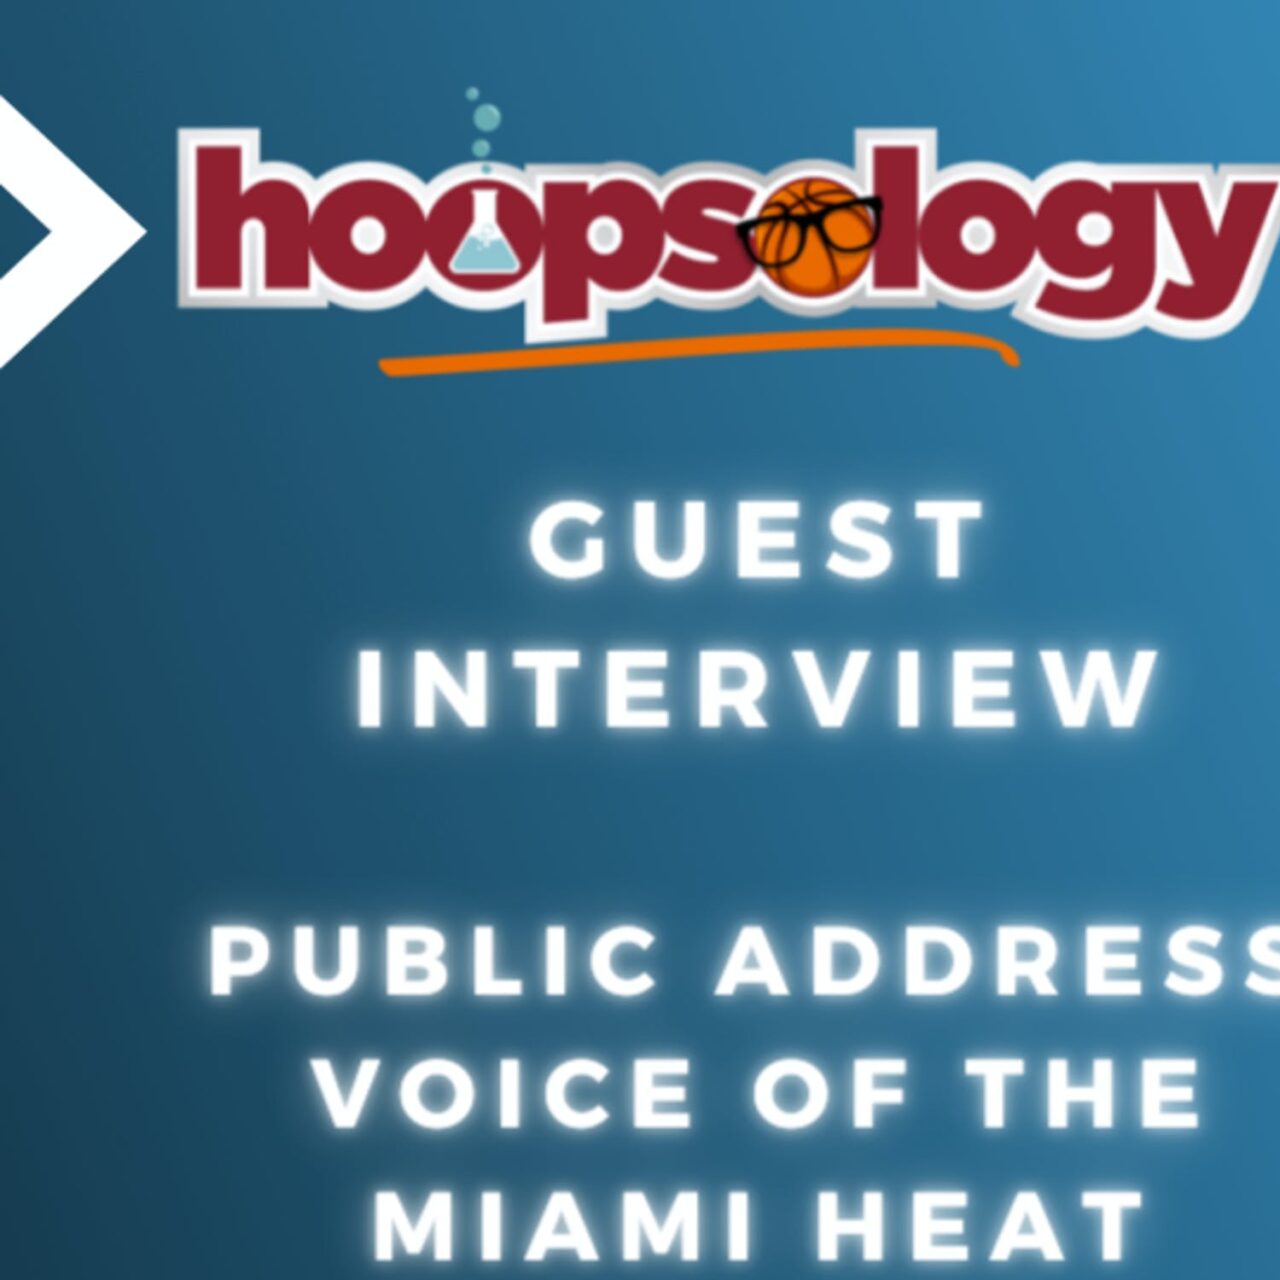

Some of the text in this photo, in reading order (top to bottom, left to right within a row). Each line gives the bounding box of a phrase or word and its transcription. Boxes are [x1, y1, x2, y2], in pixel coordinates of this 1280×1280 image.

[529, 499, 982, 580] GUEST
[358, 649, 1158, 728] INTERVIEW
[210, 924, 655, 997] PUBLIC
[310, 1057, 1199, 1130] VOICE OF THE
[375, 1191, 1144, 1262] MIAMI HEAT
